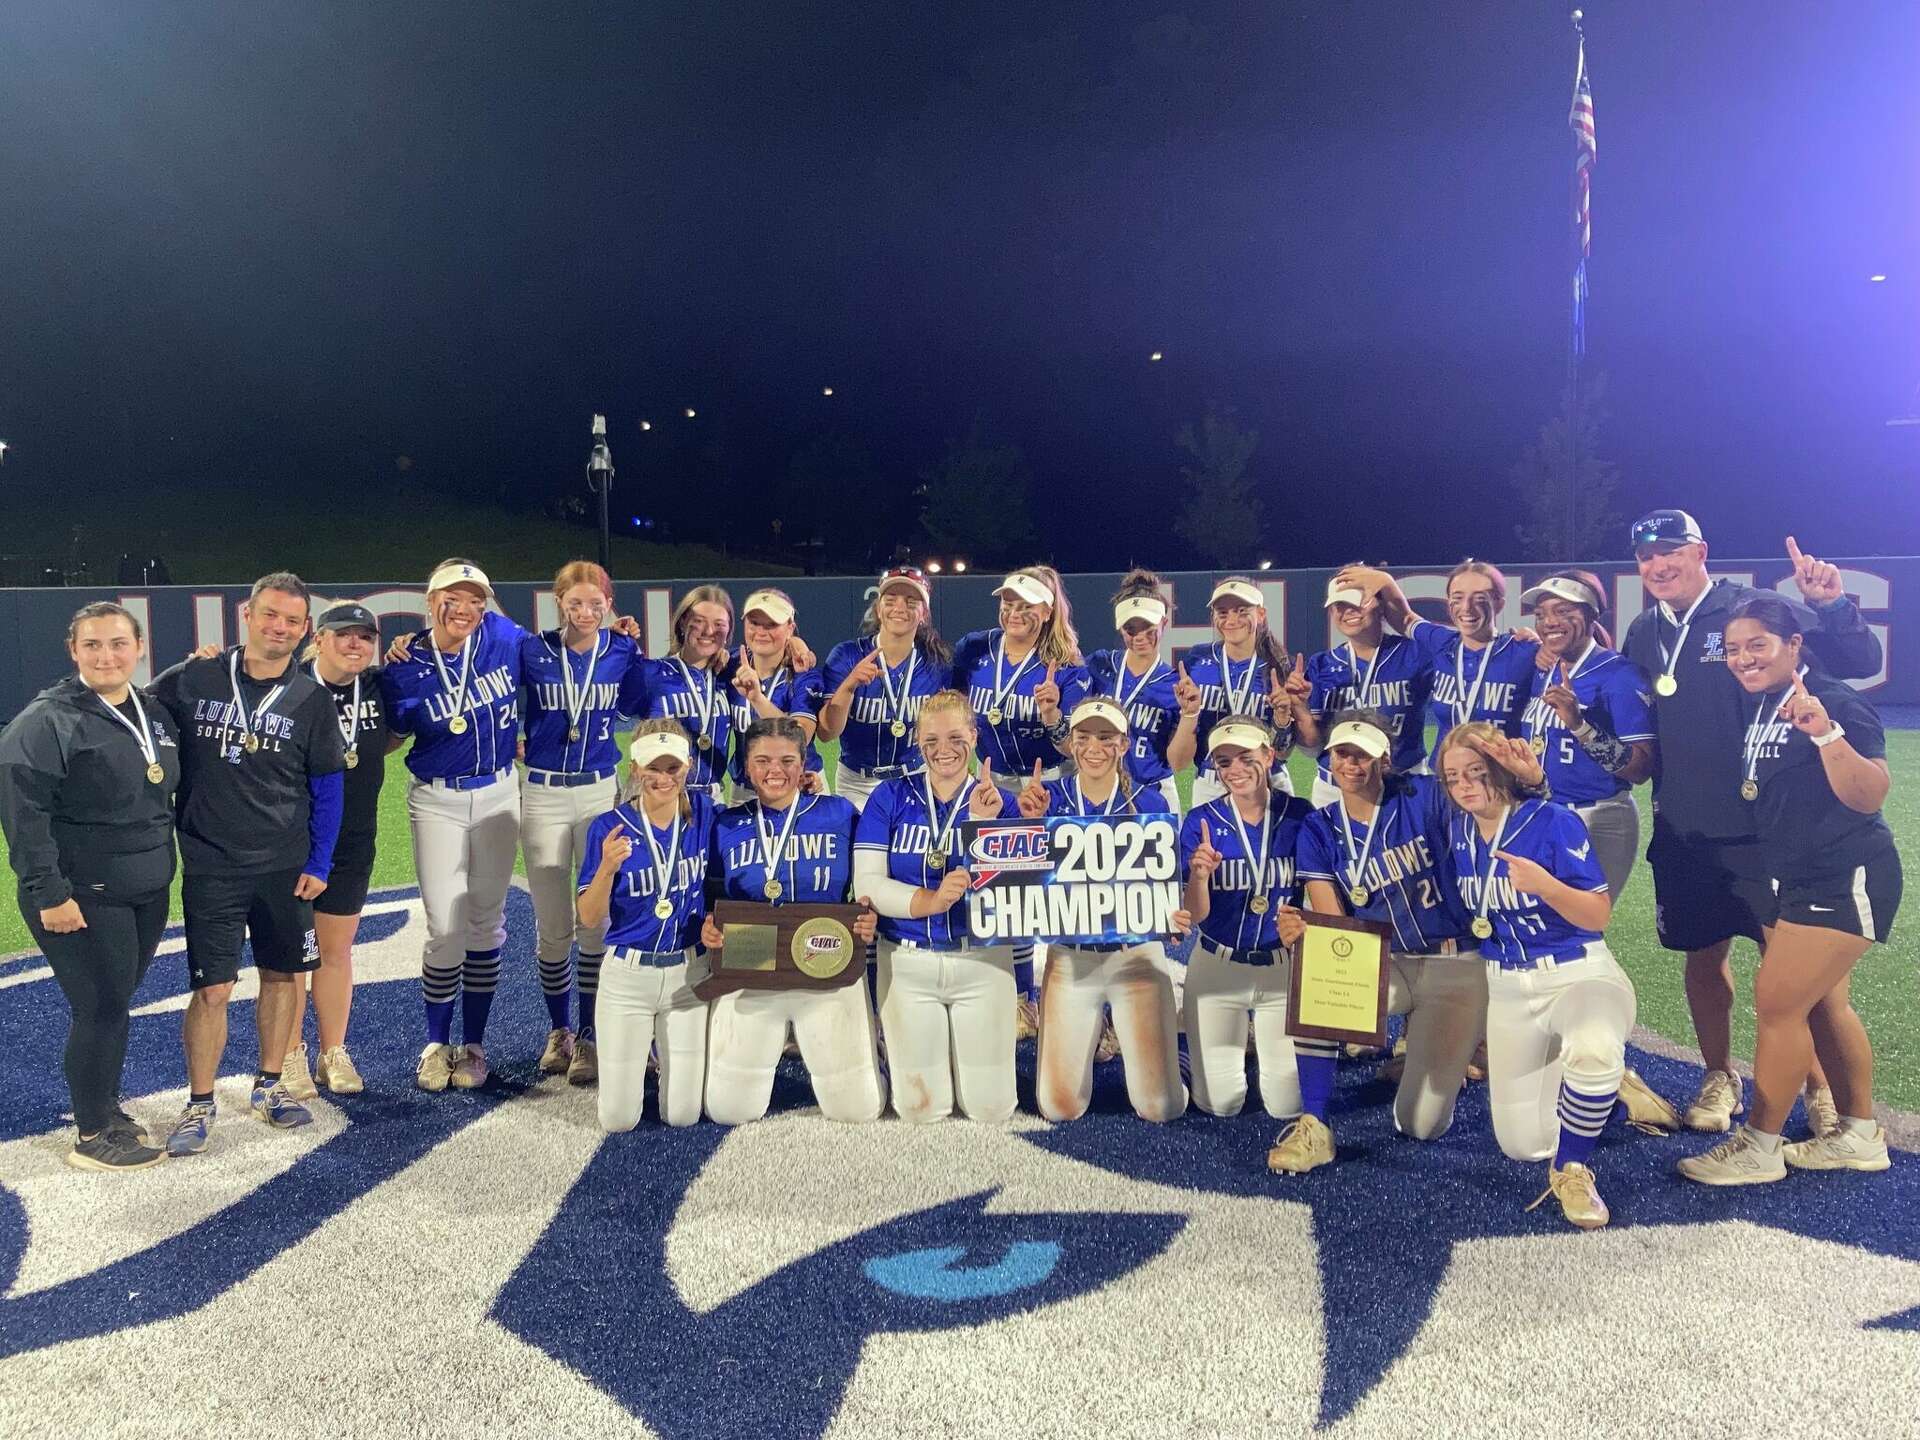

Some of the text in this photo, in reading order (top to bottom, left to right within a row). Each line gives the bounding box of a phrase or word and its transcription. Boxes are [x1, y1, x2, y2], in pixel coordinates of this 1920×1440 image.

[536, 683, 619, 711] LUOWE
[662, 689, 730, 719] LUOW
[849, 694, 930, 724] UDLW
[969, 685, 1042, 722] LUOW
[500, 699, 518, 730] 24
[598, 717, 610, 741] 3
[196, 725, 281, 752] SOFTBLL
[1135, 735, 1148, 758] 6
[1560, 738, 1574, 764] 5
[730, 833, 838, 871] LUOWE
[892, 823, 963, 857] LUDO
[983, 832, 1050, 858] CIAC
[1054, 821, 1177, 882] 2023
[627, 848, 708, 897] LUOWE
[814, 866, 830, 891] 11
[1212, 857, 1300, 890] LUDOW
[1346, 835, 1435, 893] DLOWE
[970, 882, 1182, 938] CHAMPION
